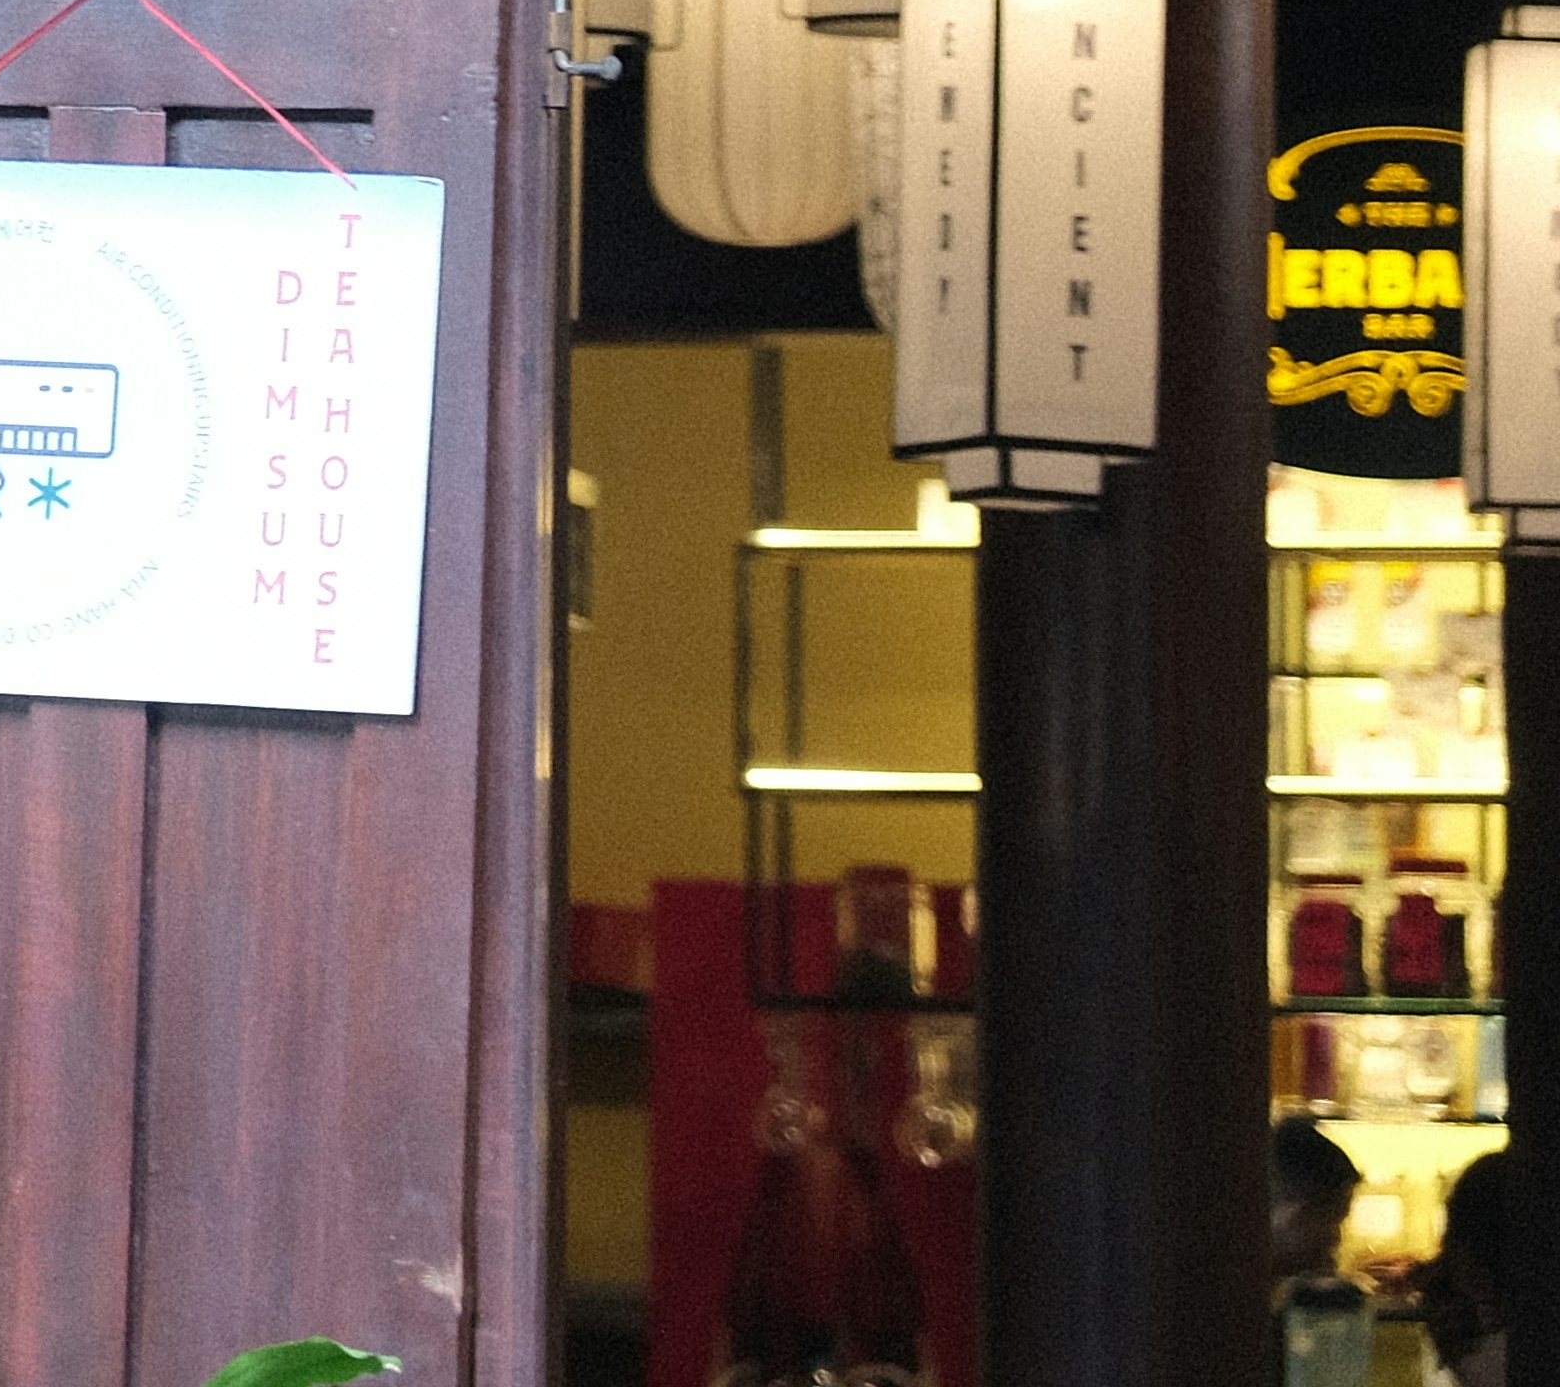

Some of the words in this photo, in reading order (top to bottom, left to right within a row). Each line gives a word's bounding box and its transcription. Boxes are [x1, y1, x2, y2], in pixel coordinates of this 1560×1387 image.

[96, 241, 128, 270] AIR
[128, 264, 210, 409] CONDITIONING
[176, 414, 211, 519] UPSTAIRS
[328, 212, 364, 365] TEA
[312, 398, 353, 665] HOUSE
